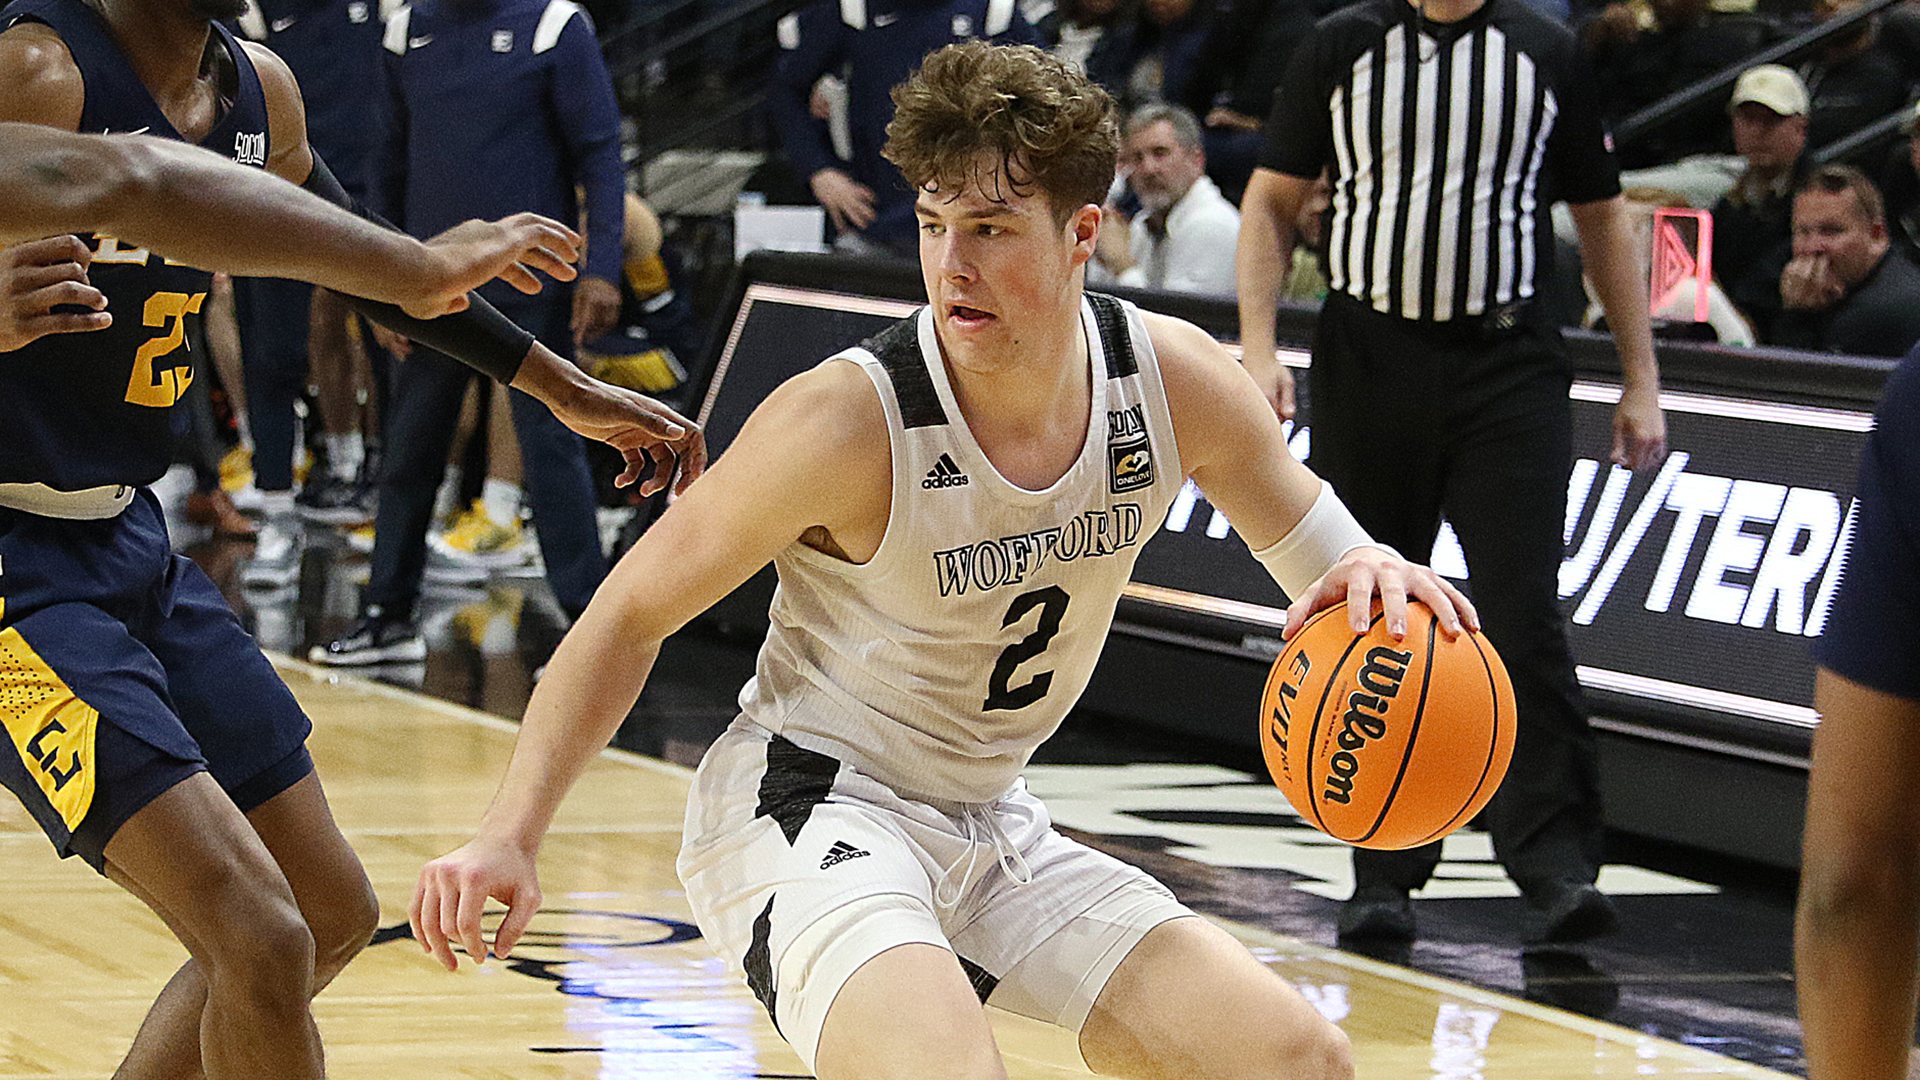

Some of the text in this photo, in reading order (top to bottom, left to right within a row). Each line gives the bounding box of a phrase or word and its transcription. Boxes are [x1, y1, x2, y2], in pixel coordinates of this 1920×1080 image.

[921, 474, 969, 490] adidas
[933, 503, 1142, 597] WOFFORD
[982, 584, 1071, 712] 2
[1271, 649, 1312, 752] EVO
[1323, 646, 1413, 804] Wilson
[819, 850, 872, 870] adidas
